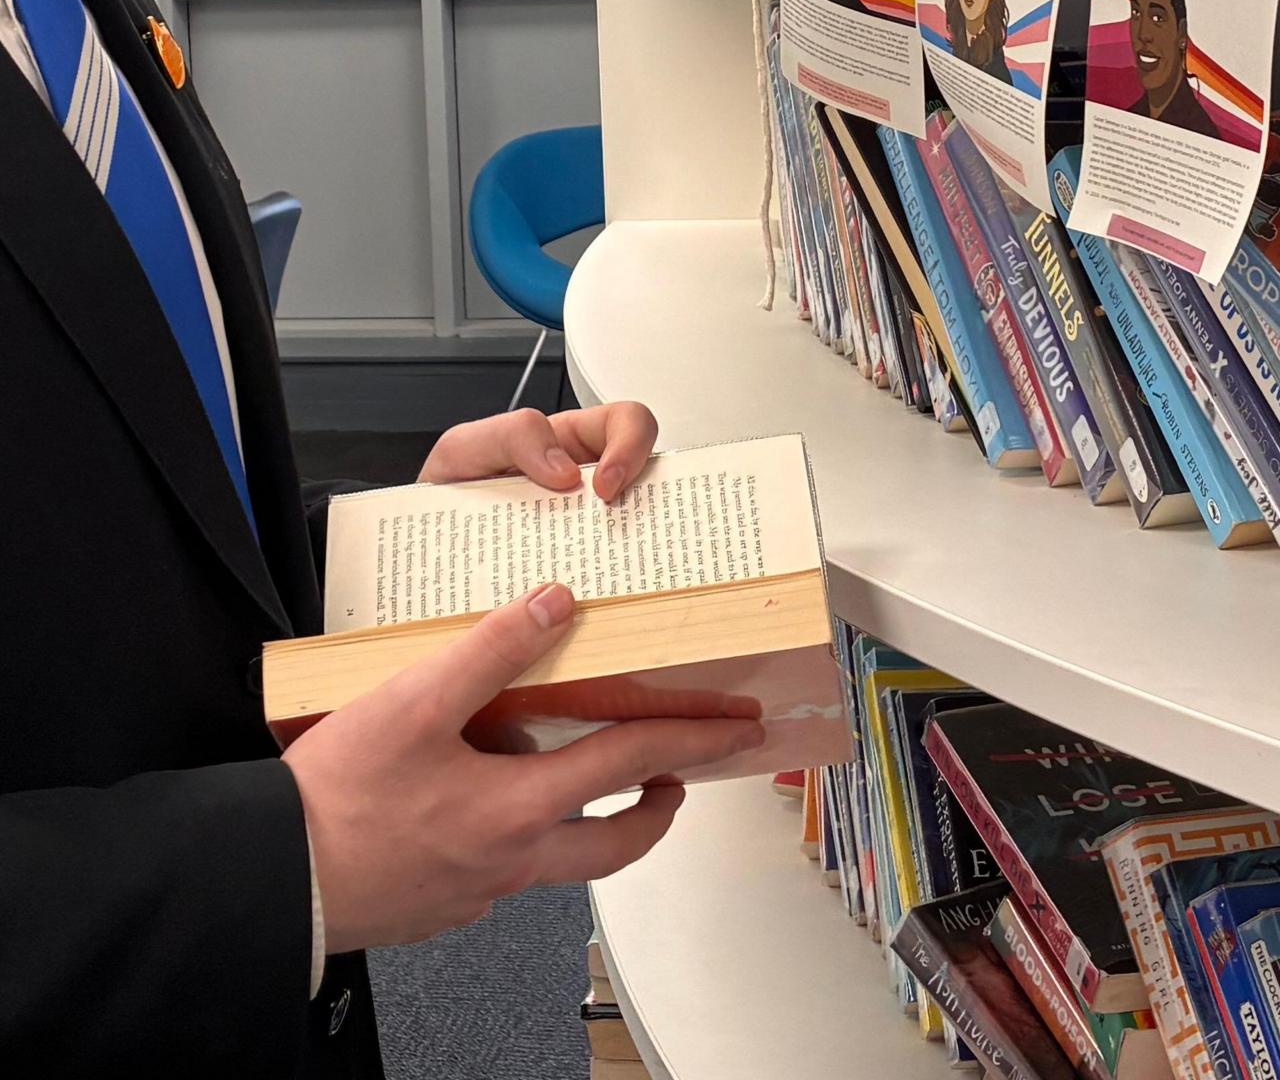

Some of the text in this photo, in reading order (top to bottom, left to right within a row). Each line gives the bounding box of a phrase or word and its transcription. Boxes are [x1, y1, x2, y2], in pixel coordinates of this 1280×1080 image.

[883, 127, 957, 330] CHALLENGE TOM
[1000, 235, 1075, 404] Truly DEVIOUS
[1024, 212, 1085, 341] TUNNELS
[1127, 269, 1183, 361] HOLLY JACKSON
[1183, 303, 1215, 353] PENNY
[1117, 308, 1210, 499] UNLADYLIKE ROBIN STEVENS
[1224, 373, 1269, 456] SECRETS
[1235, 456, 1260, 490] Joy
[984, 822, 1005, 859] KILL
[1038, 780, 1183, 818] LOSE
[911, 939, 930, 969] The
[1119, 857, 1171, 1012] RUNNING GIRL
[1254, 942, 1268, 969] THE
[1004, 924, 1041, 987] BLOOD
[1049, 992, 1098, 1071] POISON
